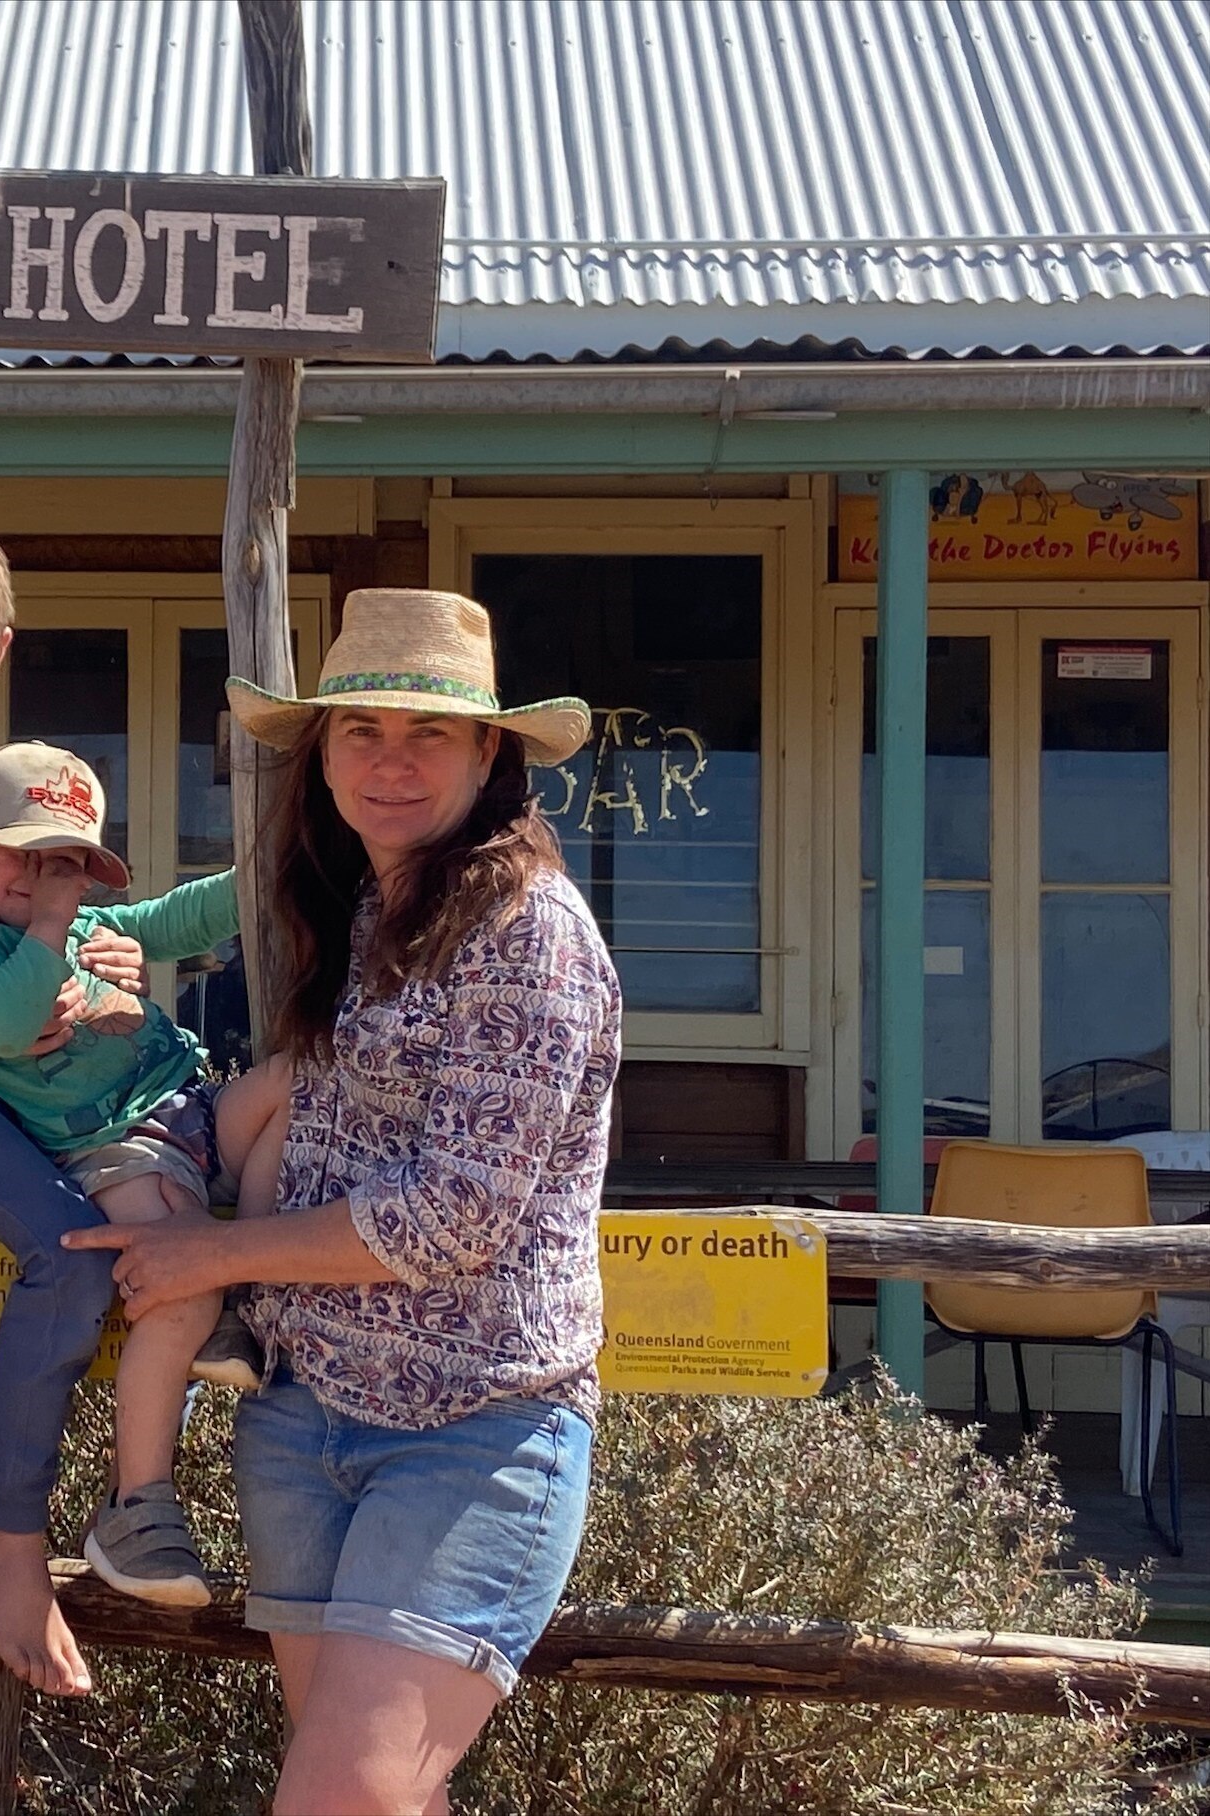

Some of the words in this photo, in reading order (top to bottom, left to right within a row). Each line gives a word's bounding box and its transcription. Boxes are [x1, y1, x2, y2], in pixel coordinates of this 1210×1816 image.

[1, 204, 364, 332] HOTEL
[929, 536, 972, 561] the
[983, 533, 1073, 560] Doctor
[1087, 530, 1181, 562] Flying
[598, 1228, 652, 1262] ury
[661, 1235, 693, 1256] or
[701, 1229, 789, 1259] death
[615, 1332, 704, 1349] Queensland
[706, 1336, 791, 1351] Government
[615, 1352, 680, 1363] Environmental
[682, 1354, 729, 1364] Protection
[731, 1356, 765, 1367] Agency
[615, 1363, 670, 1373] Queensland
[672, 1366, 698, 1375] Parks
[699, 1367, 716, 1375] and
[719, 1367, 754, 1377] Wildlife
[756, 1368, 791, 1378] Service
